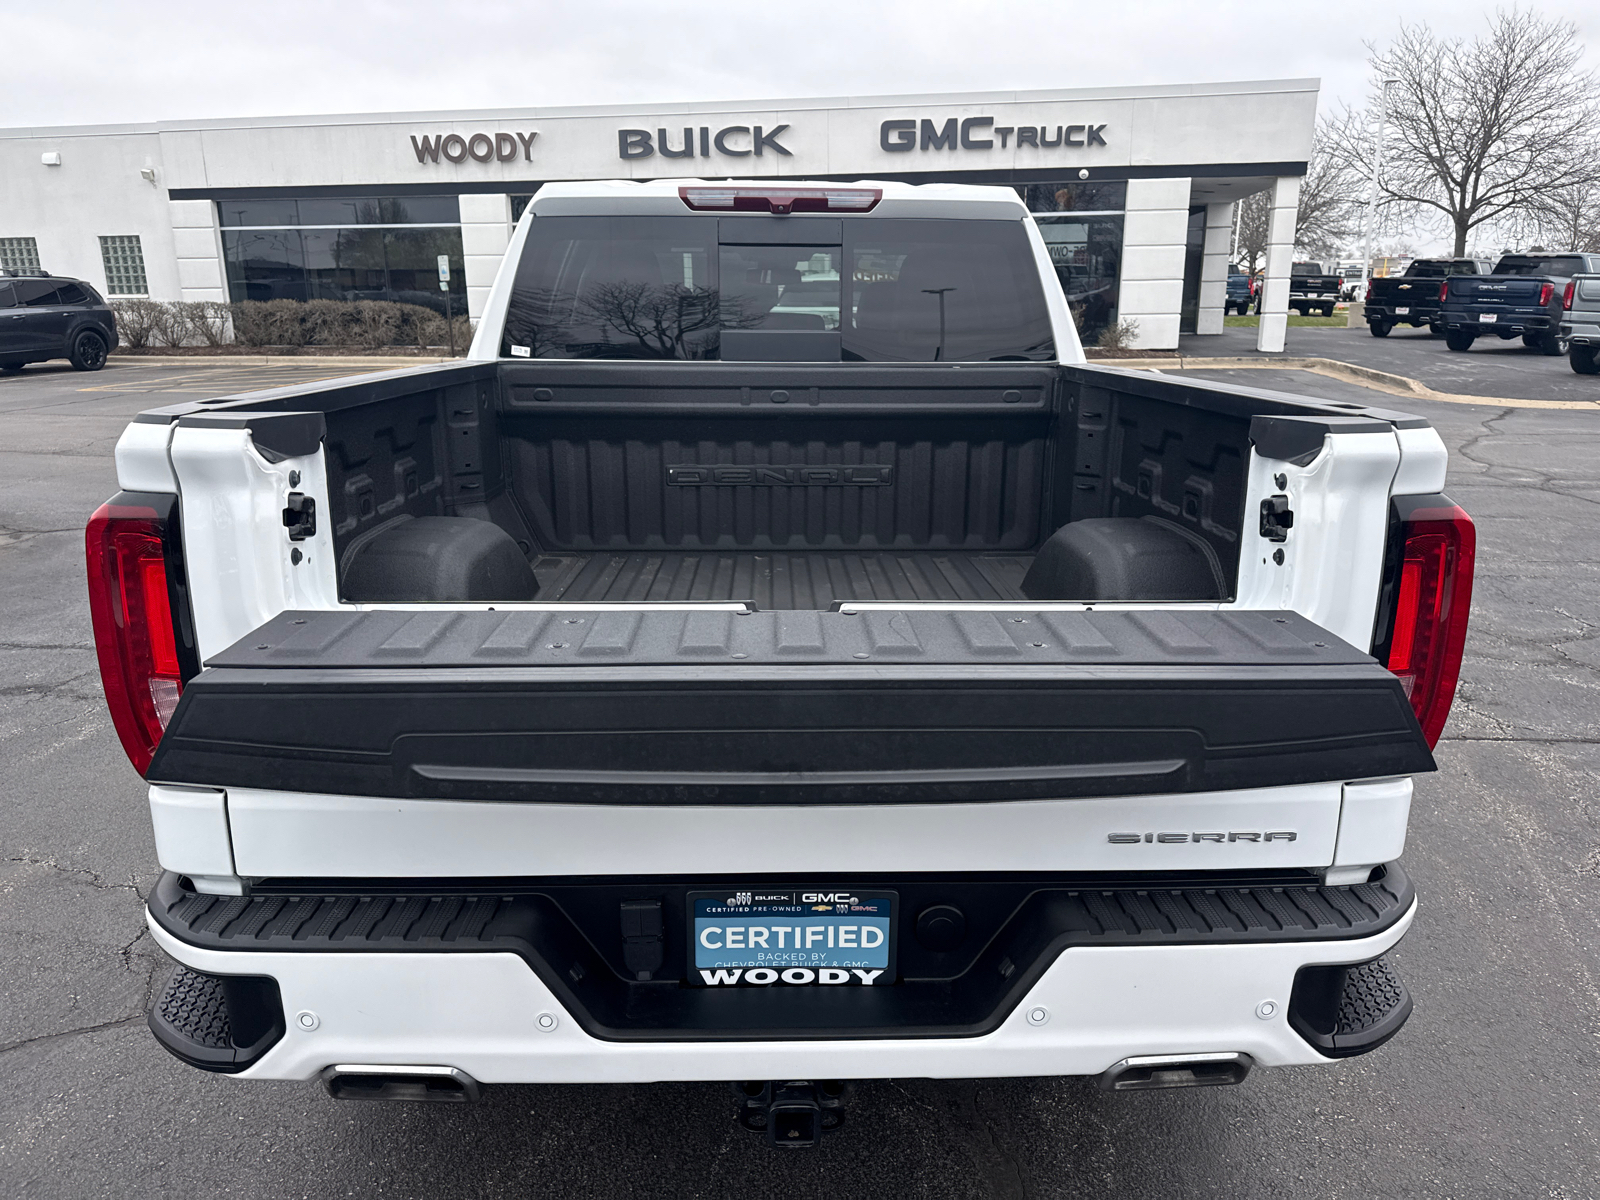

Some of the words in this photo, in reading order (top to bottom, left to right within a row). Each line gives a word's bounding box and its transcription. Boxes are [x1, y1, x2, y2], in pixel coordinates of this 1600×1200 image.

[618, 124, 794, 160] BUICK
[880, 116, 994, 152] GMC
[994, 124, 1108, 149] TRUCK
[410, 131, 538, 165] WOODY
[669, 467, 891, 484] DENALI
[1107, 831, 1298, 844] SIERRA
[801, 893, 850, 903] GMC
[700, 925, 885, 949] CERTIFIED
[757, 952, 807, 961] BACKED
[811, 952, 827, 961] BY
[699, 968, 885, 986] WOODY
